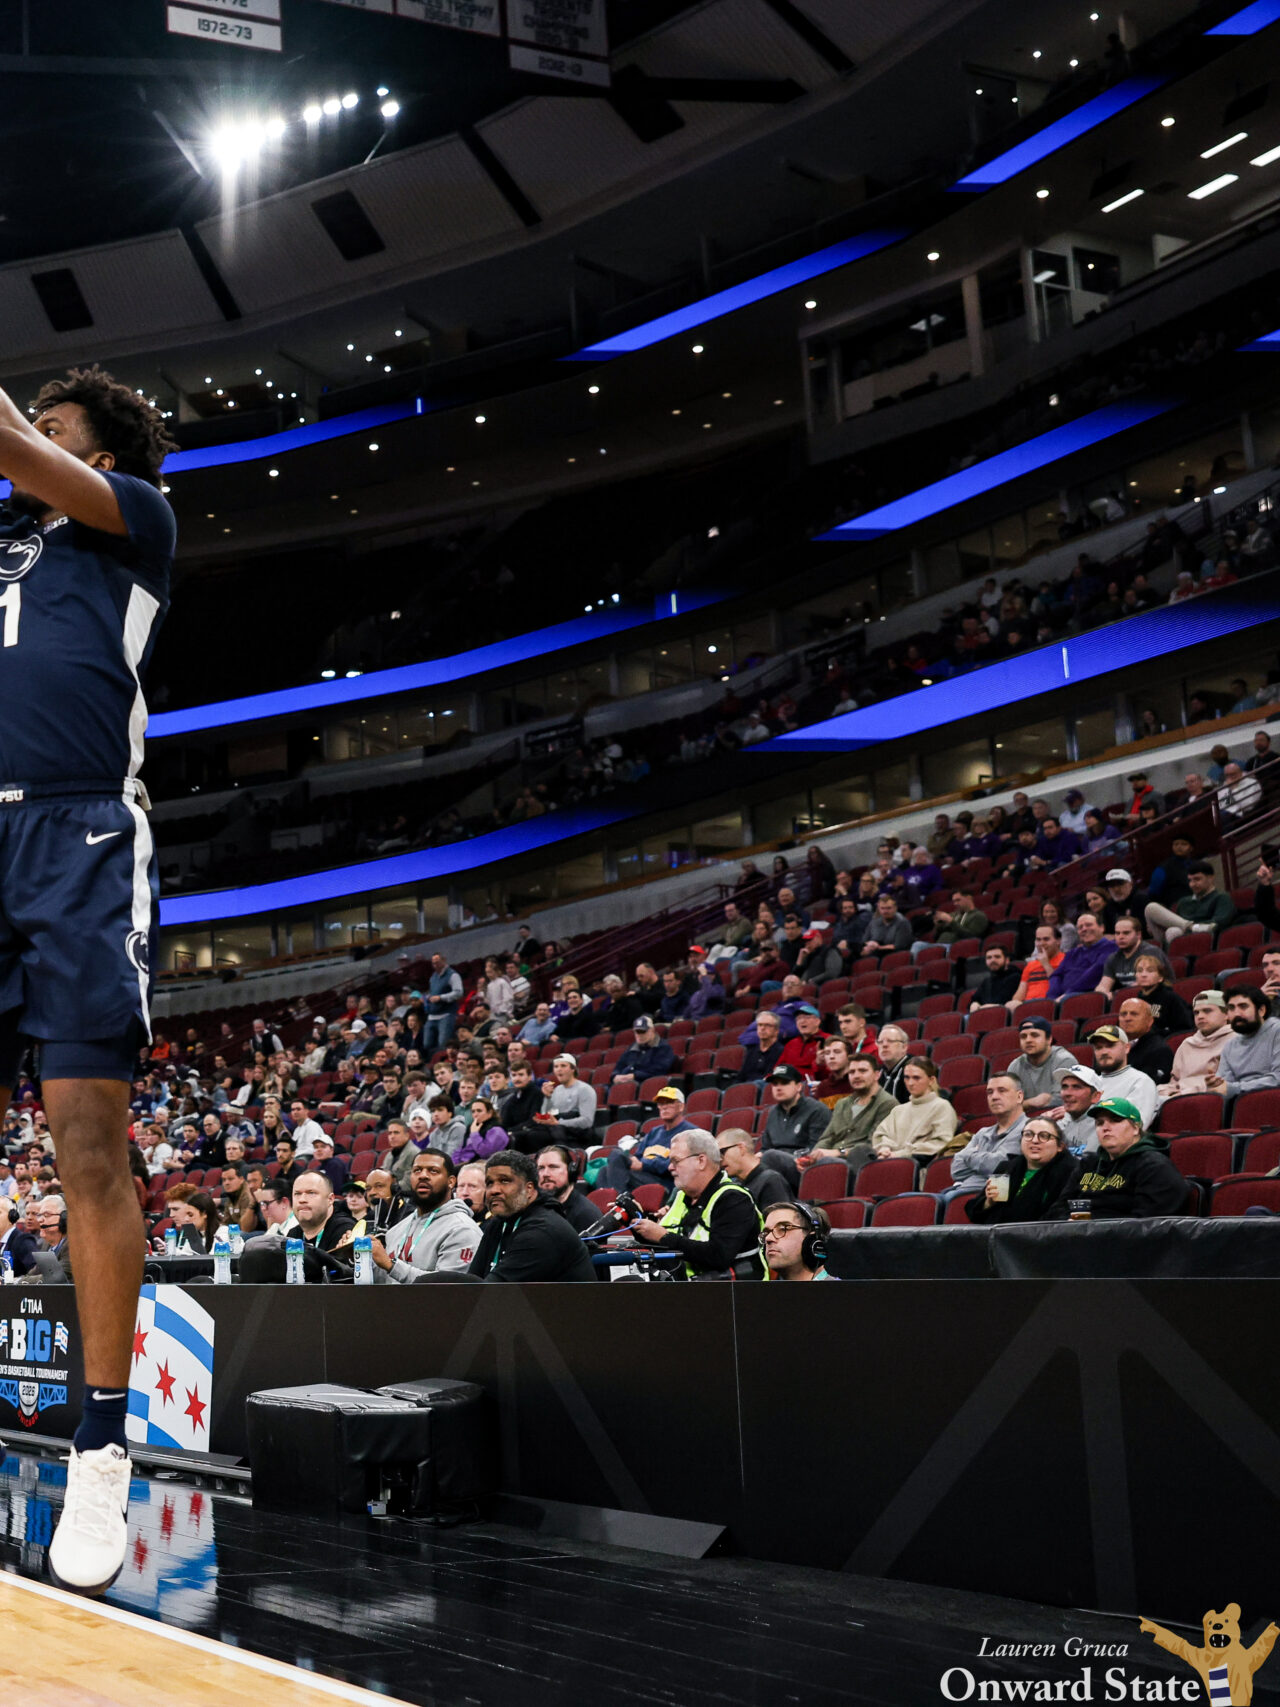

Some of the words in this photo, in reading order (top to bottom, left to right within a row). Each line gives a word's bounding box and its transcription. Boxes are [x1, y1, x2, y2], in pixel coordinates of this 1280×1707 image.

[197, 18, 253, 40] 1972-73
[7, 1366, 35, 1378] BASKETBALL
[36, 1368, 68, 1380] TOURNAMENT
